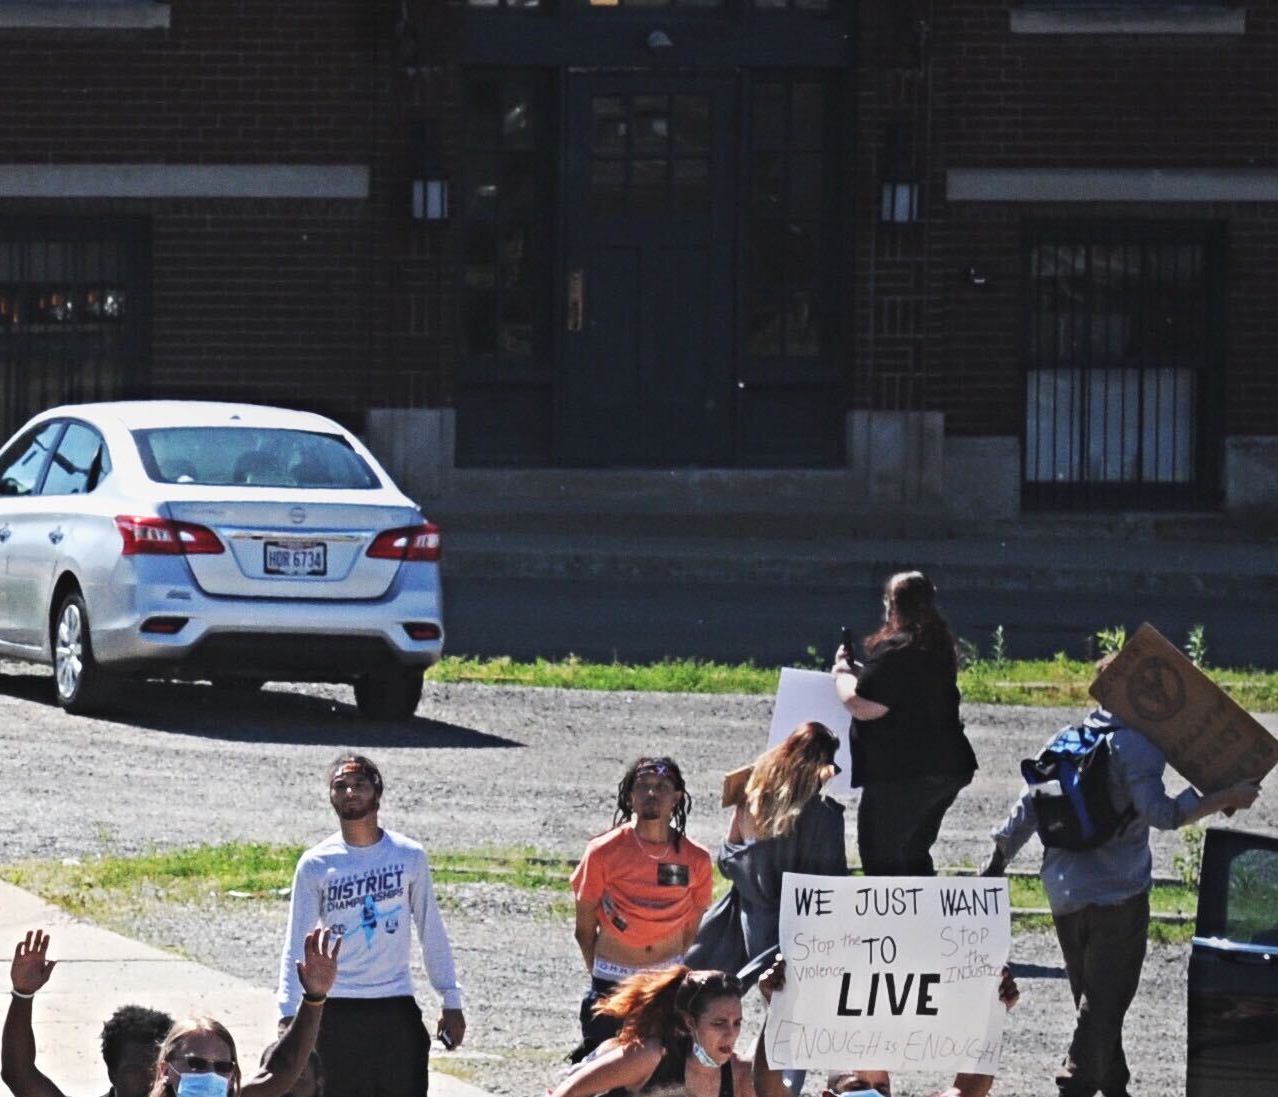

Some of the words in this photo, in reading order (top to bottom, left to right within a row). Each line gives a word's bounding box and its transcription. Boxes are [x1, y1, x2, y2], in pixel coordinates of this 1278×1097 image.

[327, 871, 403, 902] DISTRICT
[794, 887, 835, 917] WE
[855, 887, 924, 917] JUST
[939, 887, 1004, 917] WANT
[861, 935, 898, 966] TO
[944, 965, 1003, 984] INJUSTIC
[836, 972, 941, 1017] LIVE
[772, 1019, 882, 1066] ENOUGH
